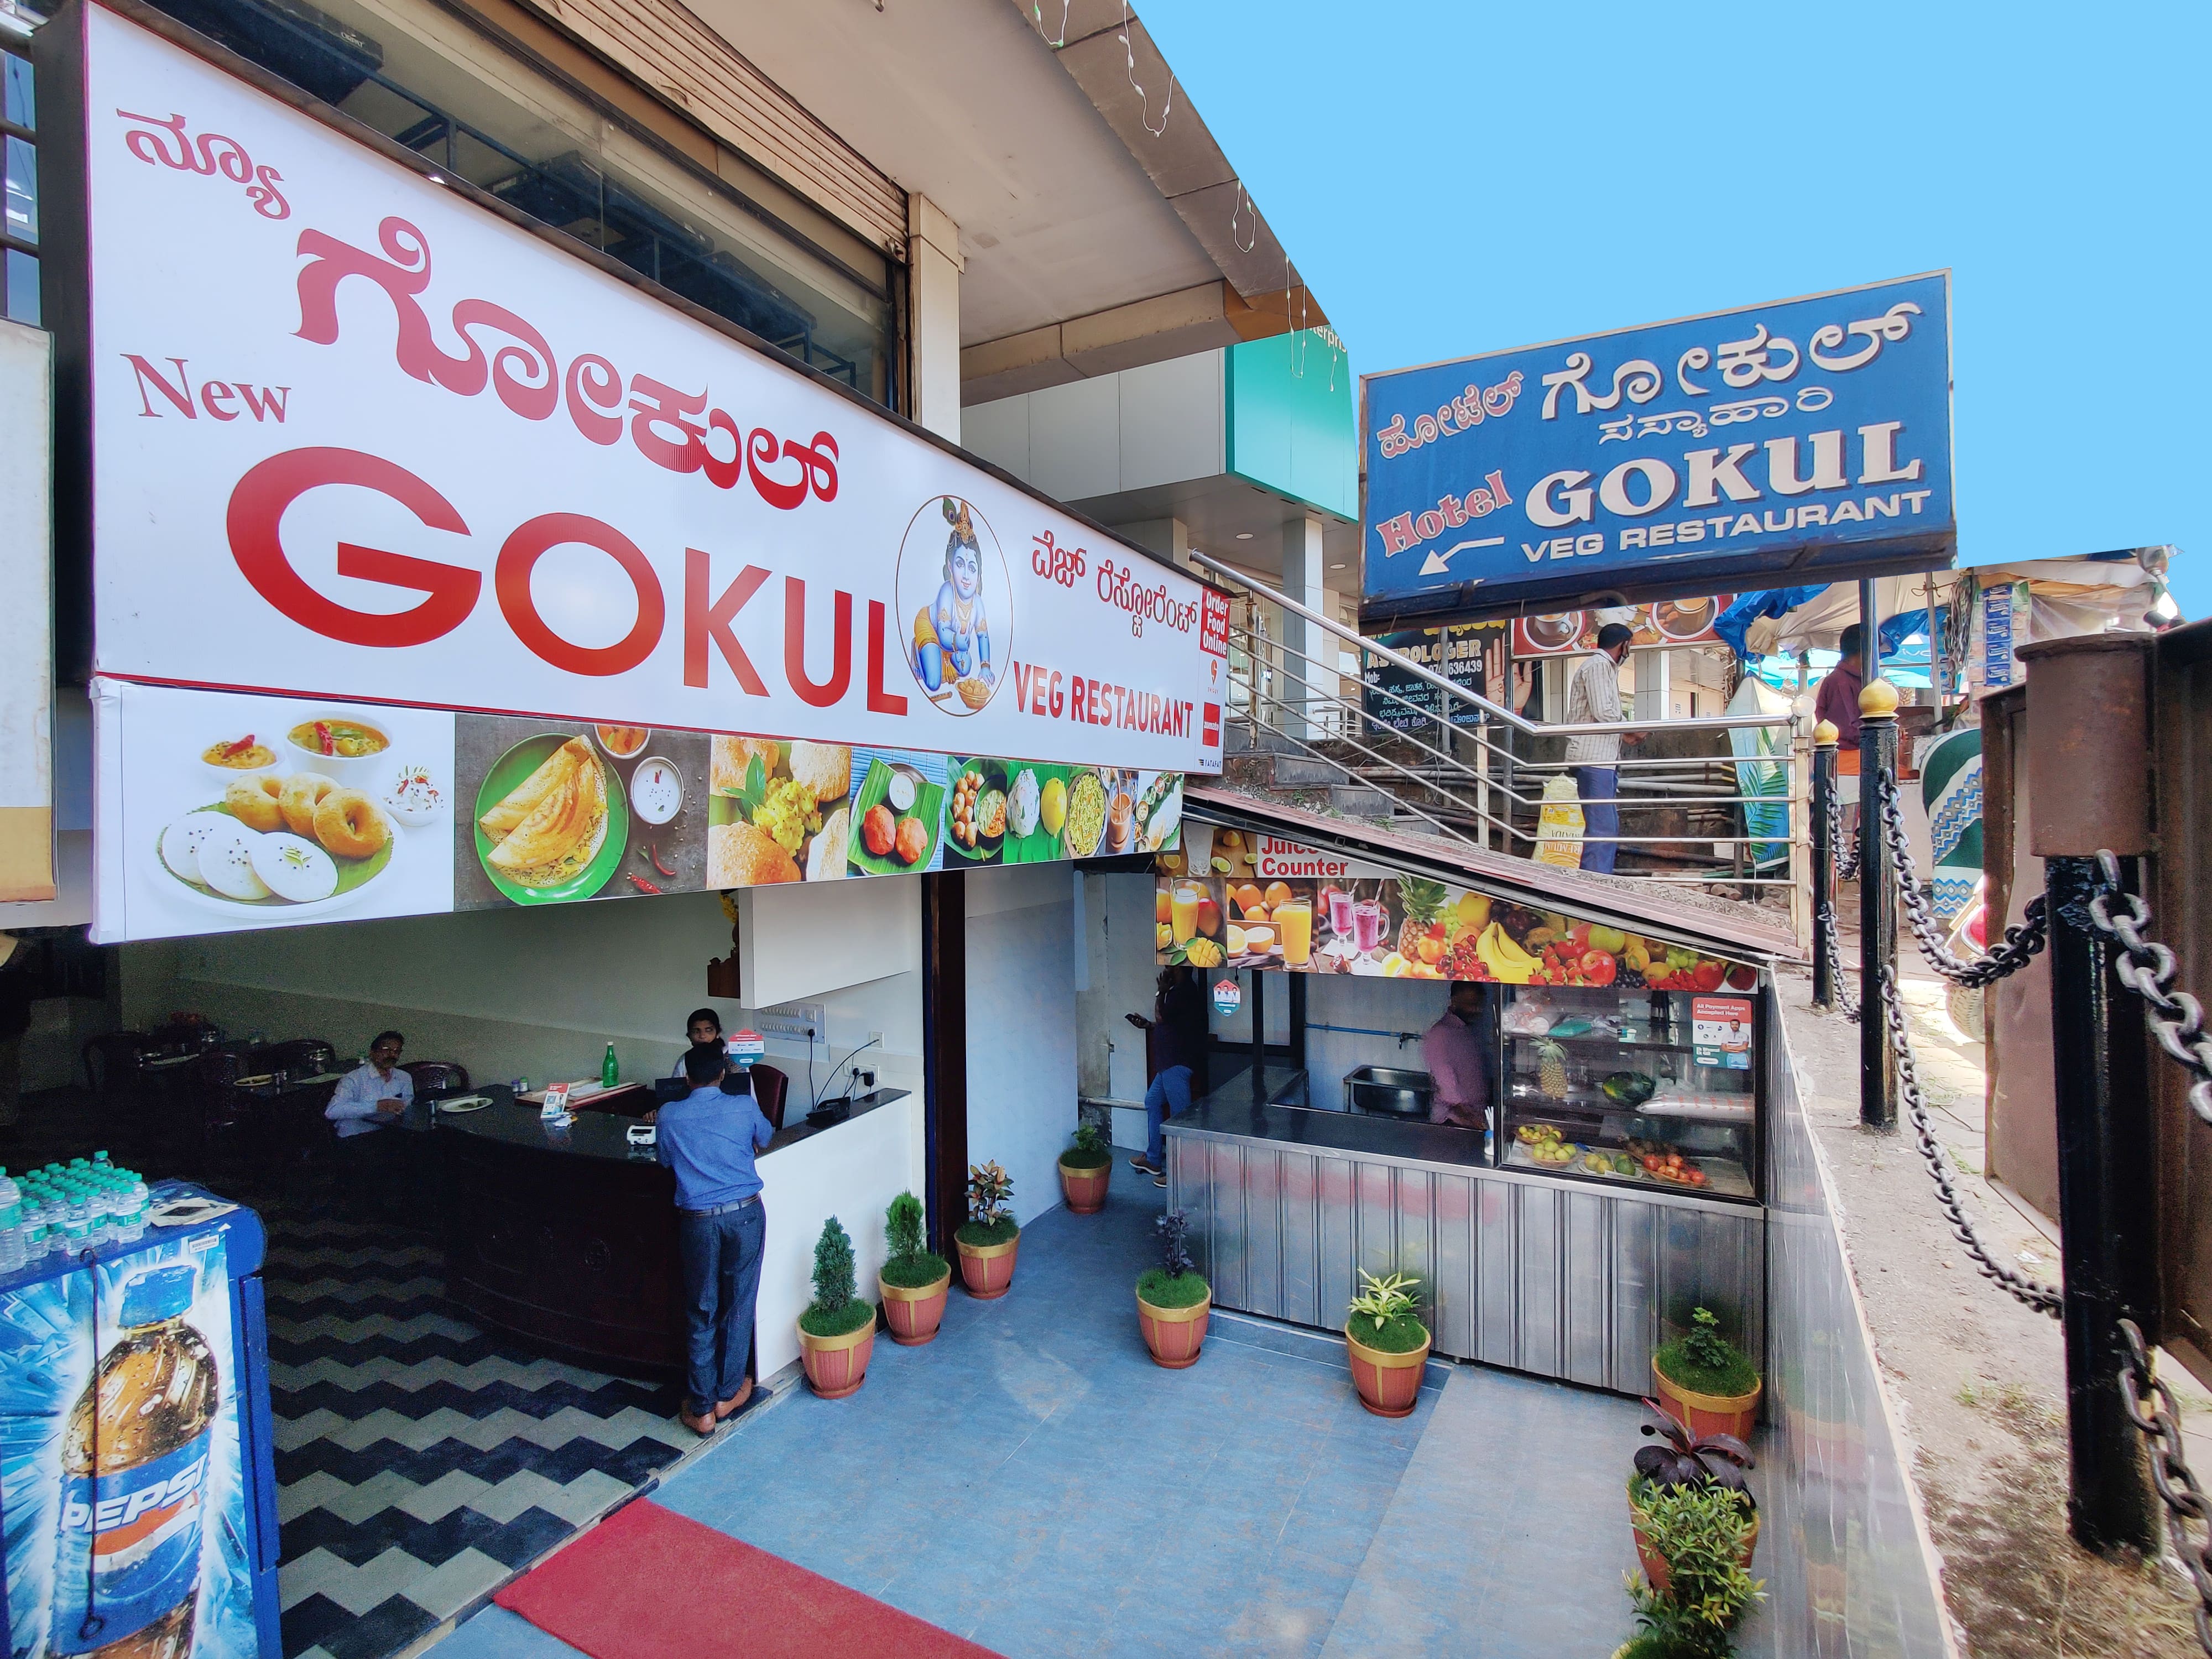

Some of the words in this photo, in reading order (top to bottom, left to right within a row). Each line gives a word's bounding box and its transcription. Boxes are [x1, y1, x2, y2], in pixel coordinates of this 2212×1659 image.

[116, 108, 291, 220] ನ್ಯೂ
[119, 353, 291, 423] New
[289, 216, 839, 510] ಗೋಕುಲ್
[1541, 301, 1922, 421] ಗೋಕುಲ್
[1377, 371, 1524, 459] ಹೋಟೆಲ್
[1376, 469, 1513, 557] Hotel
[1525, 420, 1921, 528] GOKUL
[1521, 533, 1604, 563] VEG
[1619, 489, 1932, 551] RESTAURANT
[226, 446, 908, 717] GOKUL
[1032, 529, 1087, 588] ವೆಜ್
[1097, 559, 1198, 638] ರೆಸ್ಟೋರೆಂಟ್
[1206, 591, 1228, 617] Order
[1207, 612, 1226, 635] Food
[1203, 630, 1227, 655] Online
[1013, 660, 1064, 719] VEG
[1071, 675, 1194, 739] RESTAURANT
[1262, 857, 1349, 877] Counter
[59, 1452, 208, 1533] PEPSI
